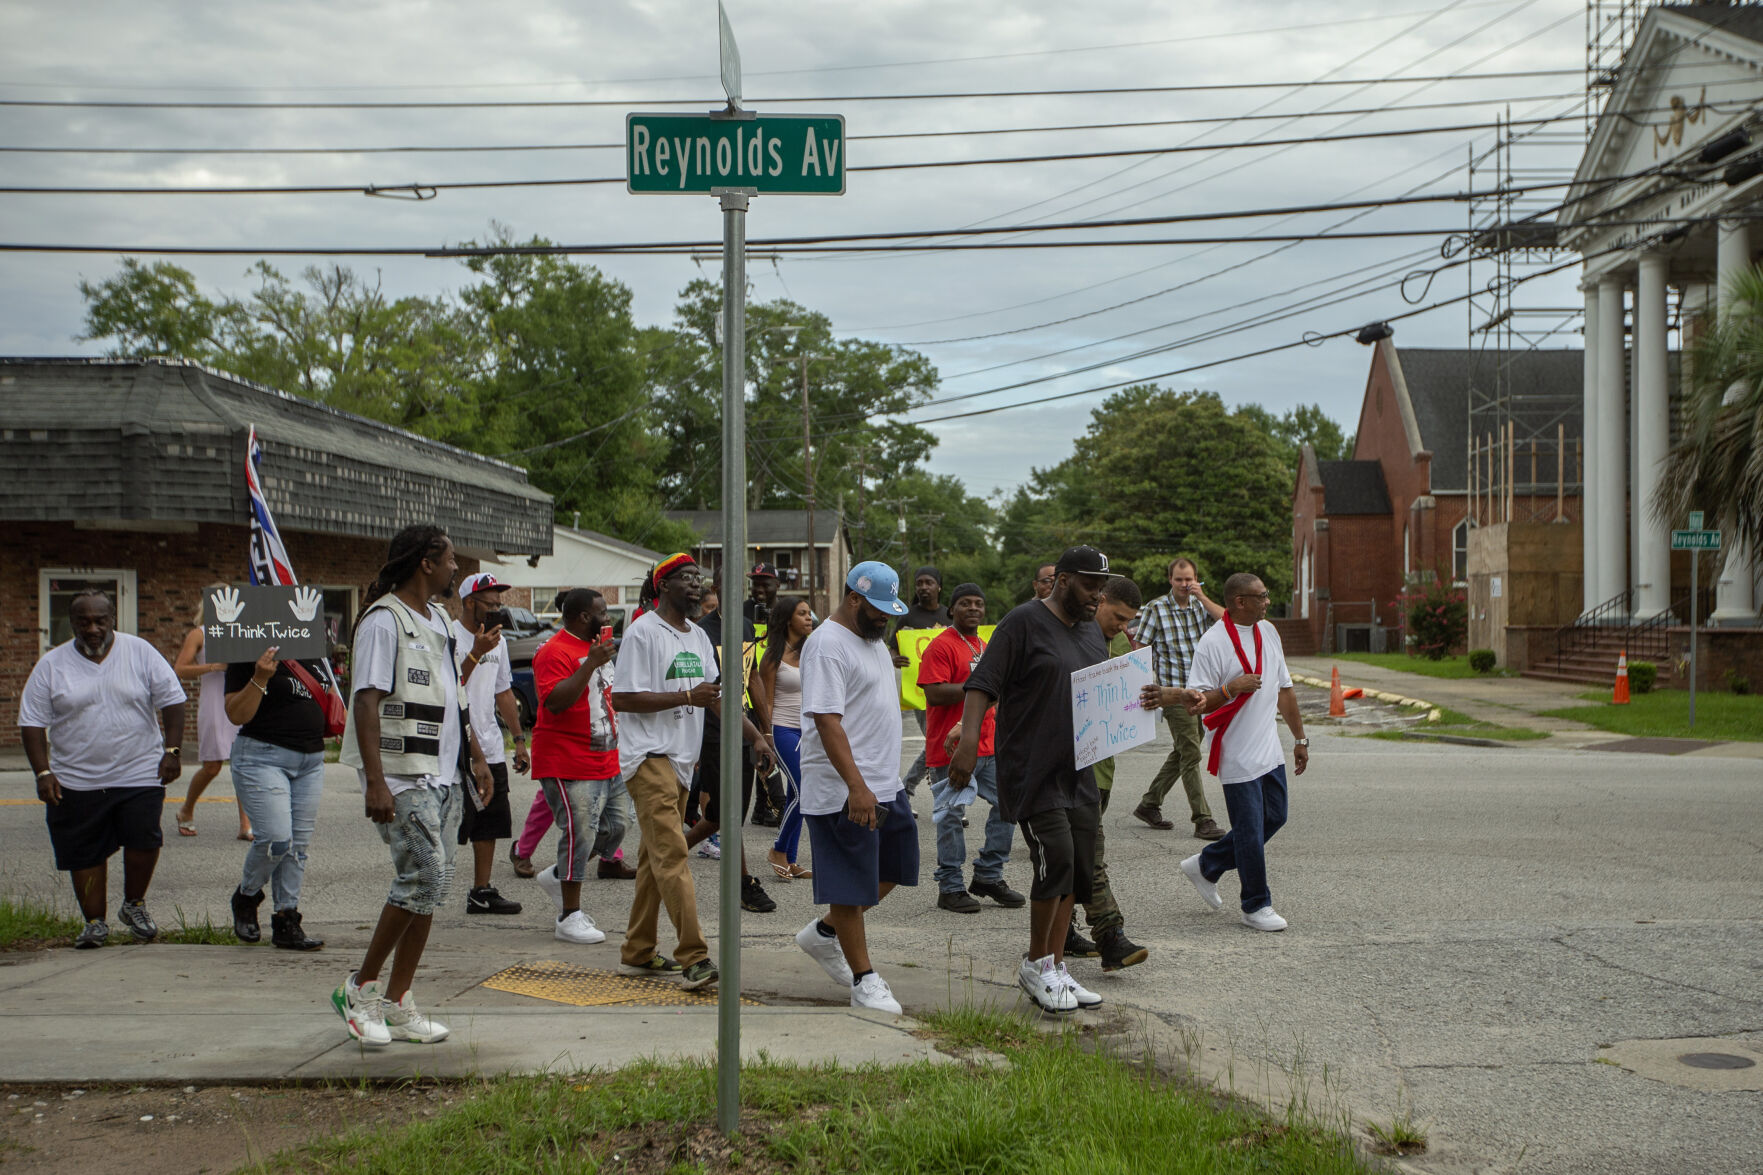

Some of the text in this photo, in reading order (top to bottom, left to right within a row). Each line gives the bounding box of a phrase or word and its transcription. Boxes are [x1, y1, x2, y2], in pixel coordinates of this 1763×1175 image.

[633, 124, 839, 188] Reynolds Av
[1098, 713, 1138, 748] Twice
